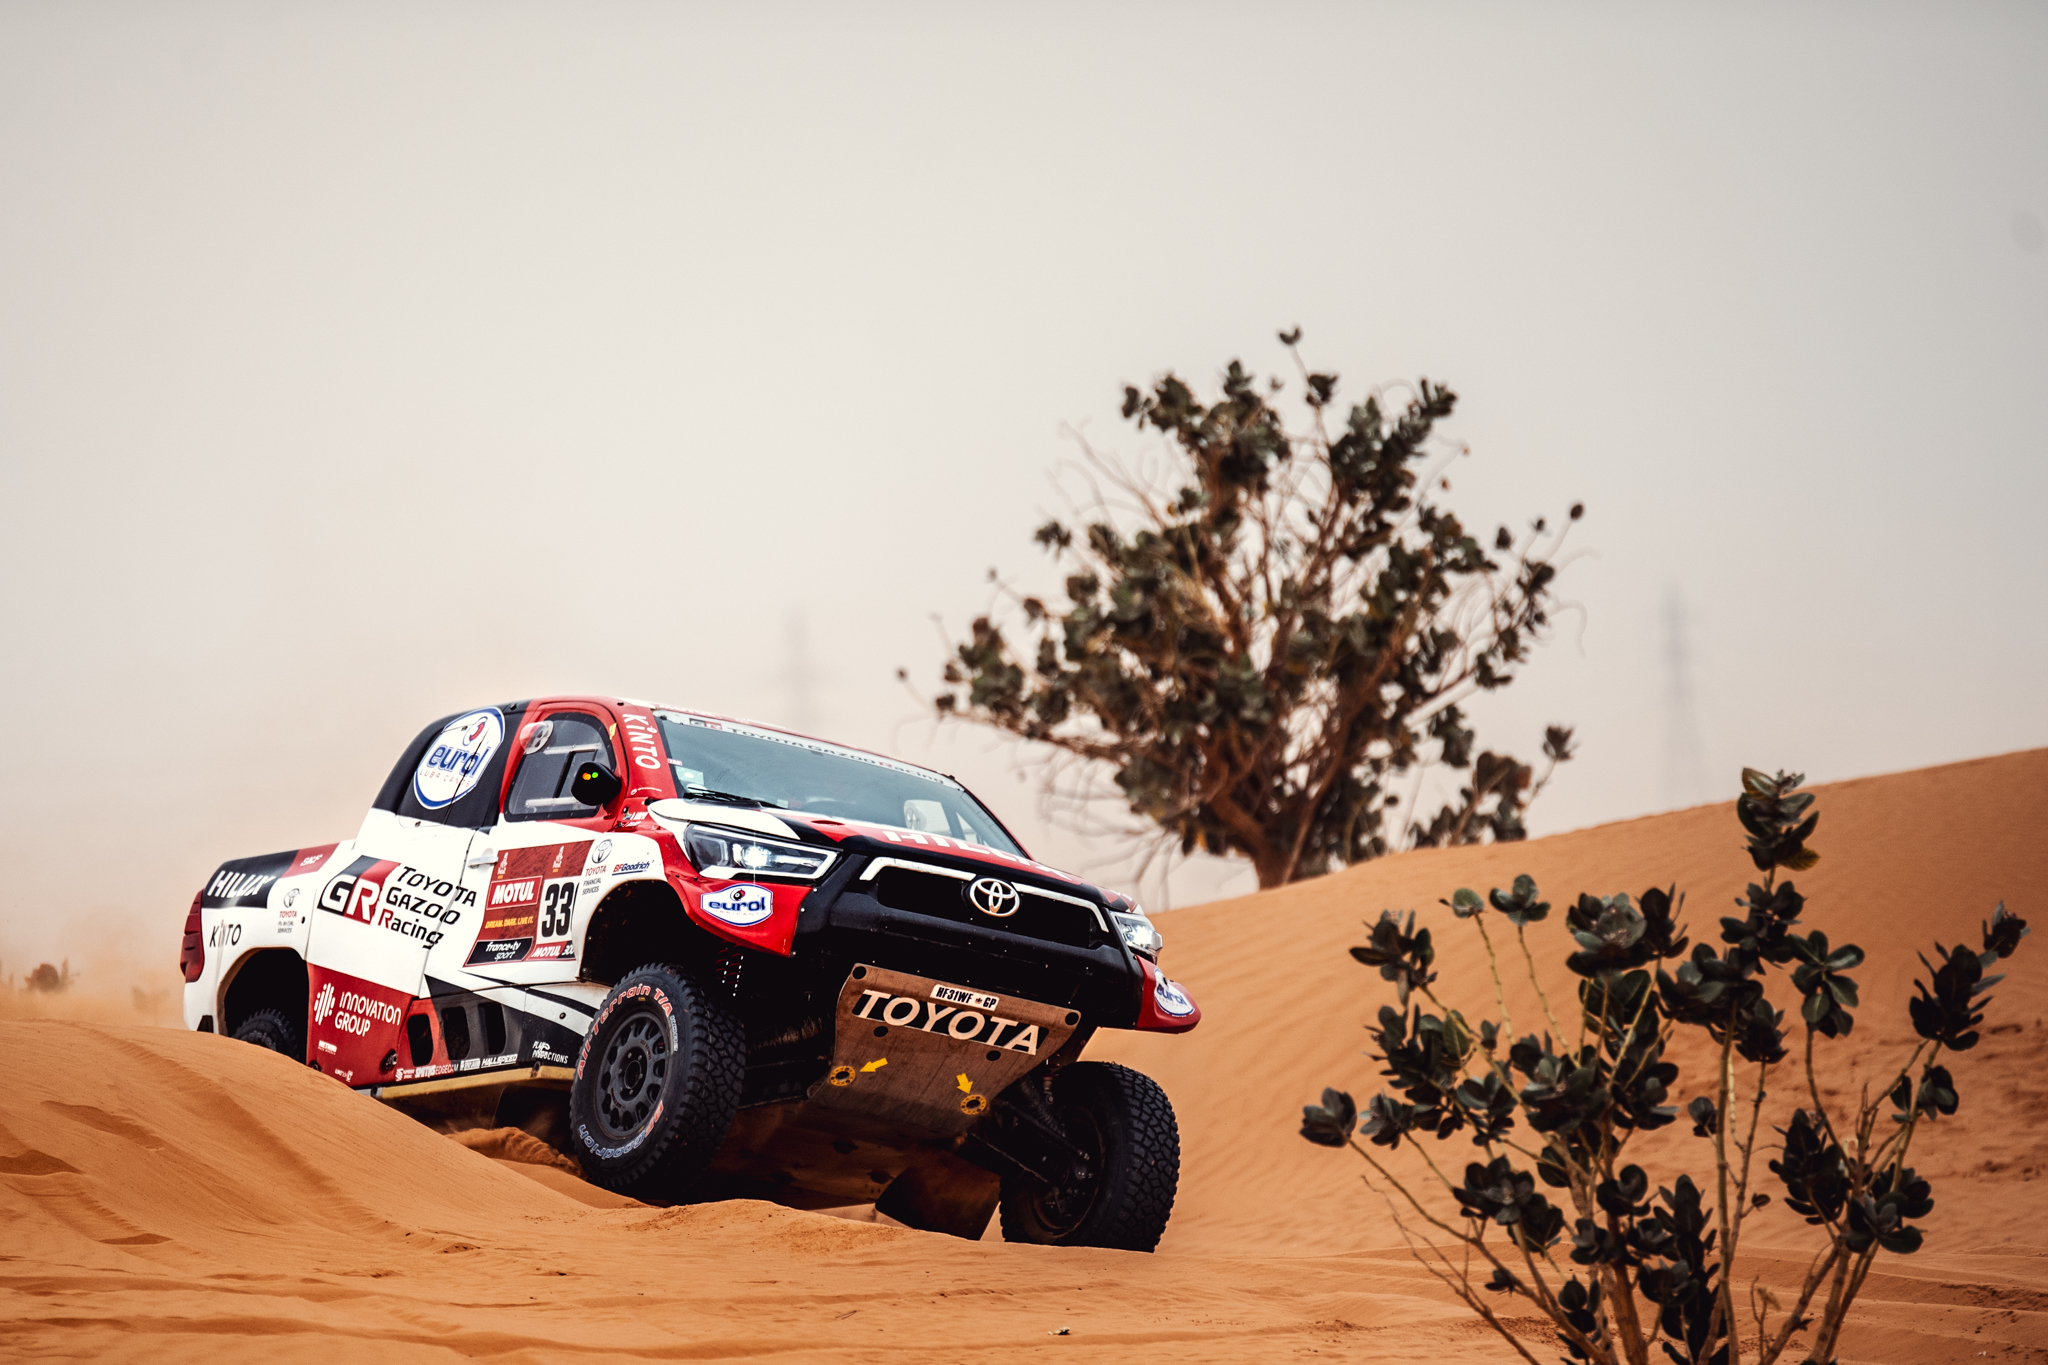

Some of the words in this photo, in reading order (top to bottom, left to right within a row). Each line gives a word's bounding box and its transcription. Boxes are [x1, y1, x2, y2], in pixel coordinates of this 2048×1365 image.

[727, 727, 804, 750] TOYOTA
[427, 745, 491, 778] eurol
[585, 865, 607, 877] TOYOTA
[612, 861, 650, 873] BFGoodrich
[206, 870, 277, 899] HILUX
[396, 866, 477, 908] TOYOTA
[491, 881, 535, 905] MOTUL
[583, 877, 602, 887] FINANCIAL
[321, 874, 380, 921] GR
[386, 886, 461, 926] GAZOO
[708, 896, 767, 912] eurol
[378, 908, 444, 950] Racing
[494, 951, 516, 962] sport
[531, 945, 562, 958] MOTUL
[339, 991, 402, 1026] INNOVATION
[936, 987, 974, 1004] HF31WF
[983, 996, 997, 1009] GP
[334, 1011, 371, 1037] GROUP
[857, 989, 1040, 1056] TOYOTA
